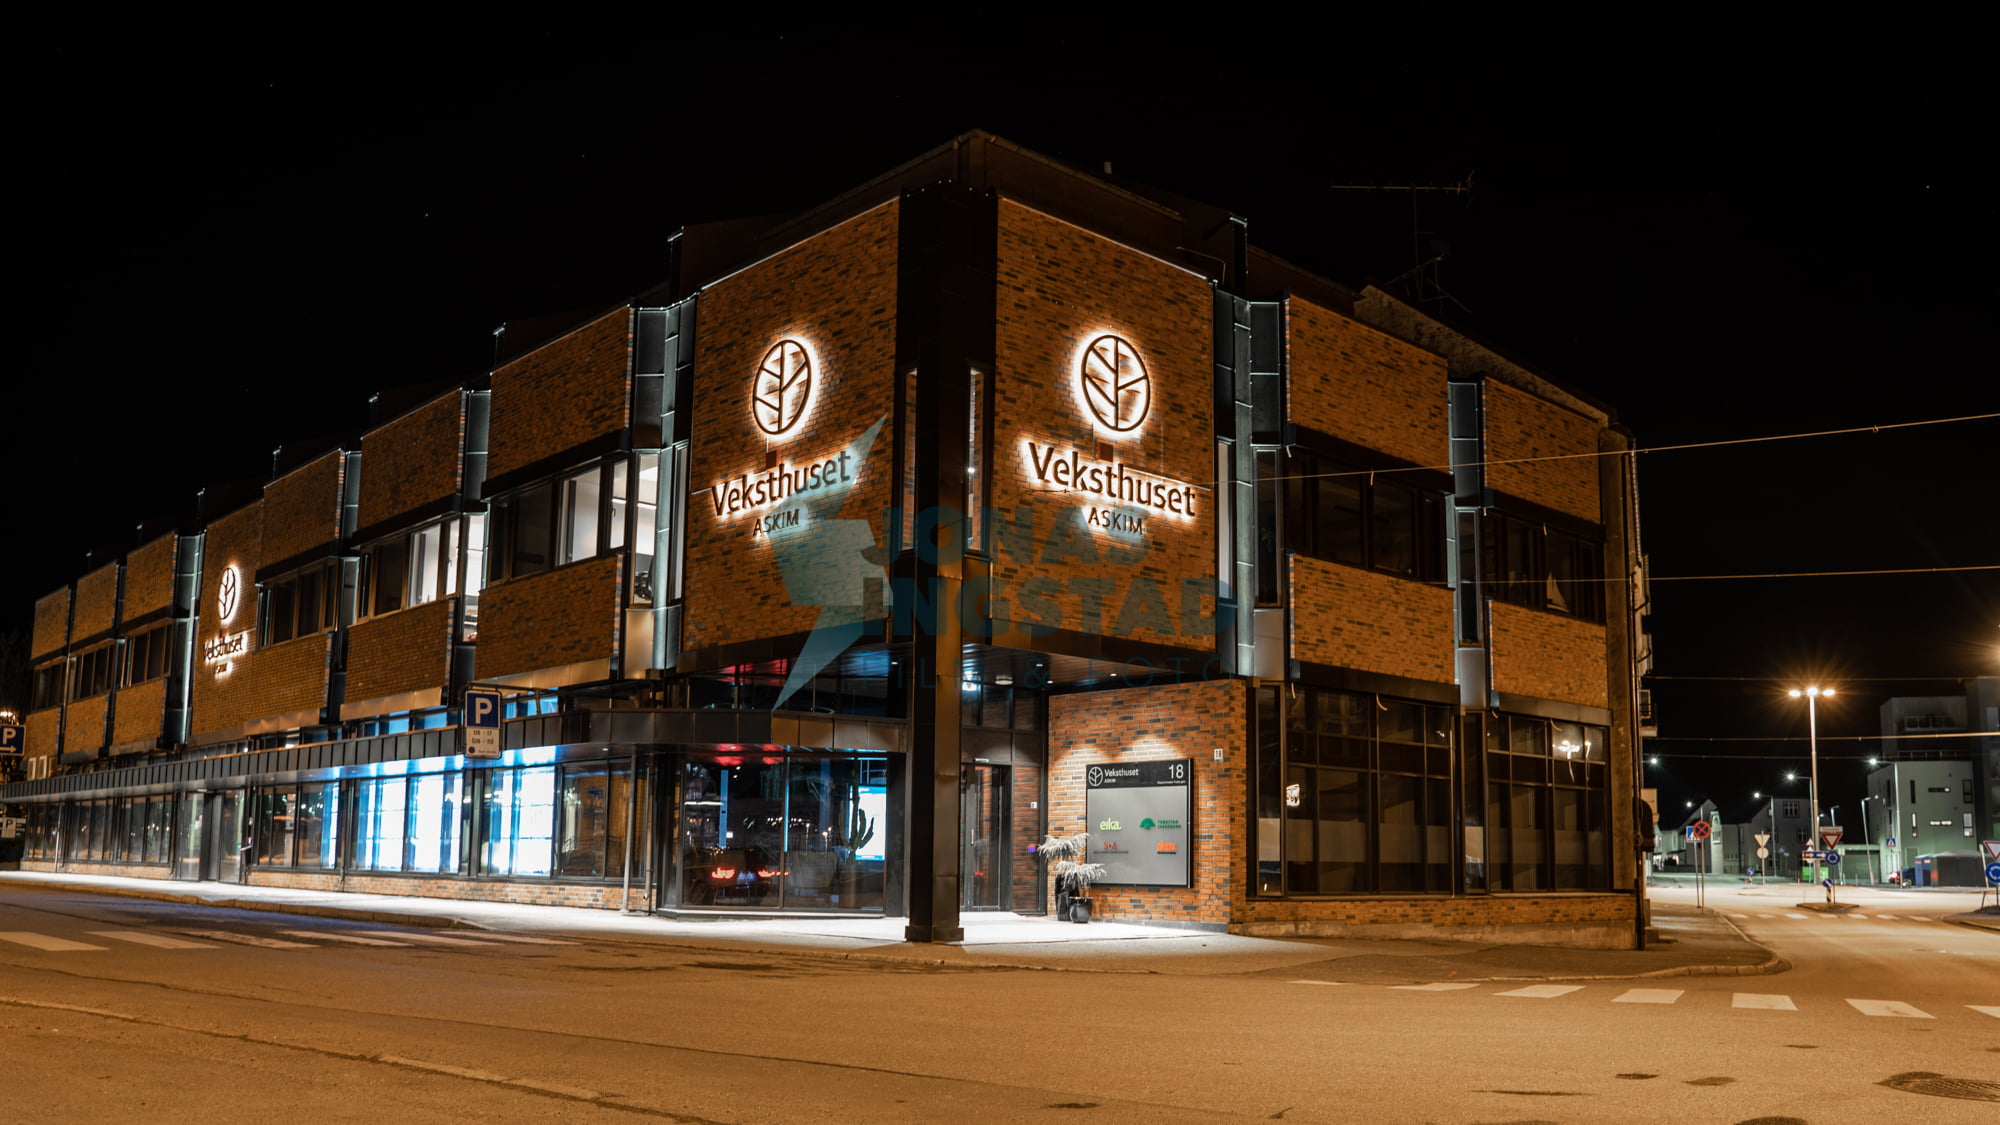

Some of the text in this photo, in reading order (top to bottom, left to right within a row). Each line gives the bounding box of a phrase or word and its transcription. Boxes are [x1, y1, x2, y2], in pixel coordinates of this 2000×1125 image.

[711, 450, 851, 517] Veksthuset
[1028, 442, 1196, 517] Veksthuset
[752, 508, 800, 536] ASKIM
[1087, 506, 1144, 535] ASKIM
[475, 697, 493, 725] P
[2, 727, 17, 745] P
[1104, 763, 1184, 779] Veksthuset 18
